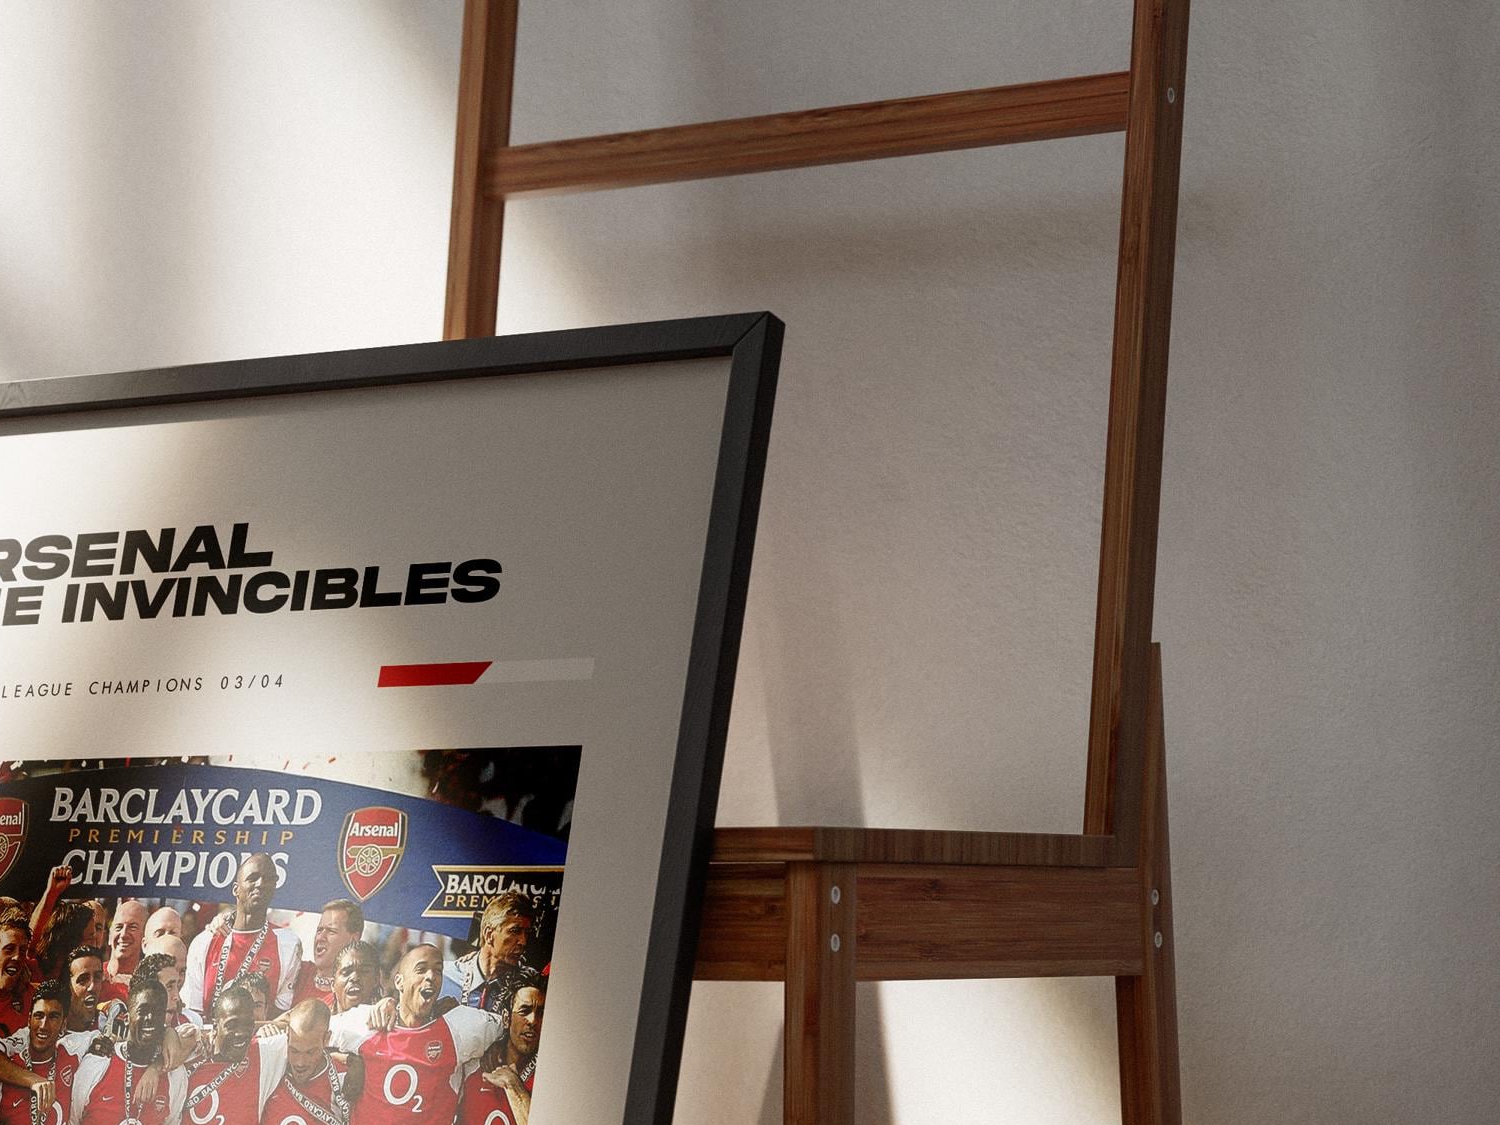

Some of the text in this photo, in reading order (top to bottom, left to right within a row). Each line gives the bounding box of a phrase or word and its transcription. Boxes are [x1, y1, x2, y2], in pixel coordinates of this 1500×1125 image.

[61, 558, 503, 624] INVINCIBLES
[2, 683, 72, 698] LEAGUE
[89, 677, 202, 695] CHAMPIONS
[221, 674, 282, 689] 03/04
[50, 787, 323, 825] BARCLAYCARD
[68, 829, 294, 845] PREMIERSHIP
[349, 822, 398, 838] Arsenal
[62, 849, 290, 888] CHAMPIOS
